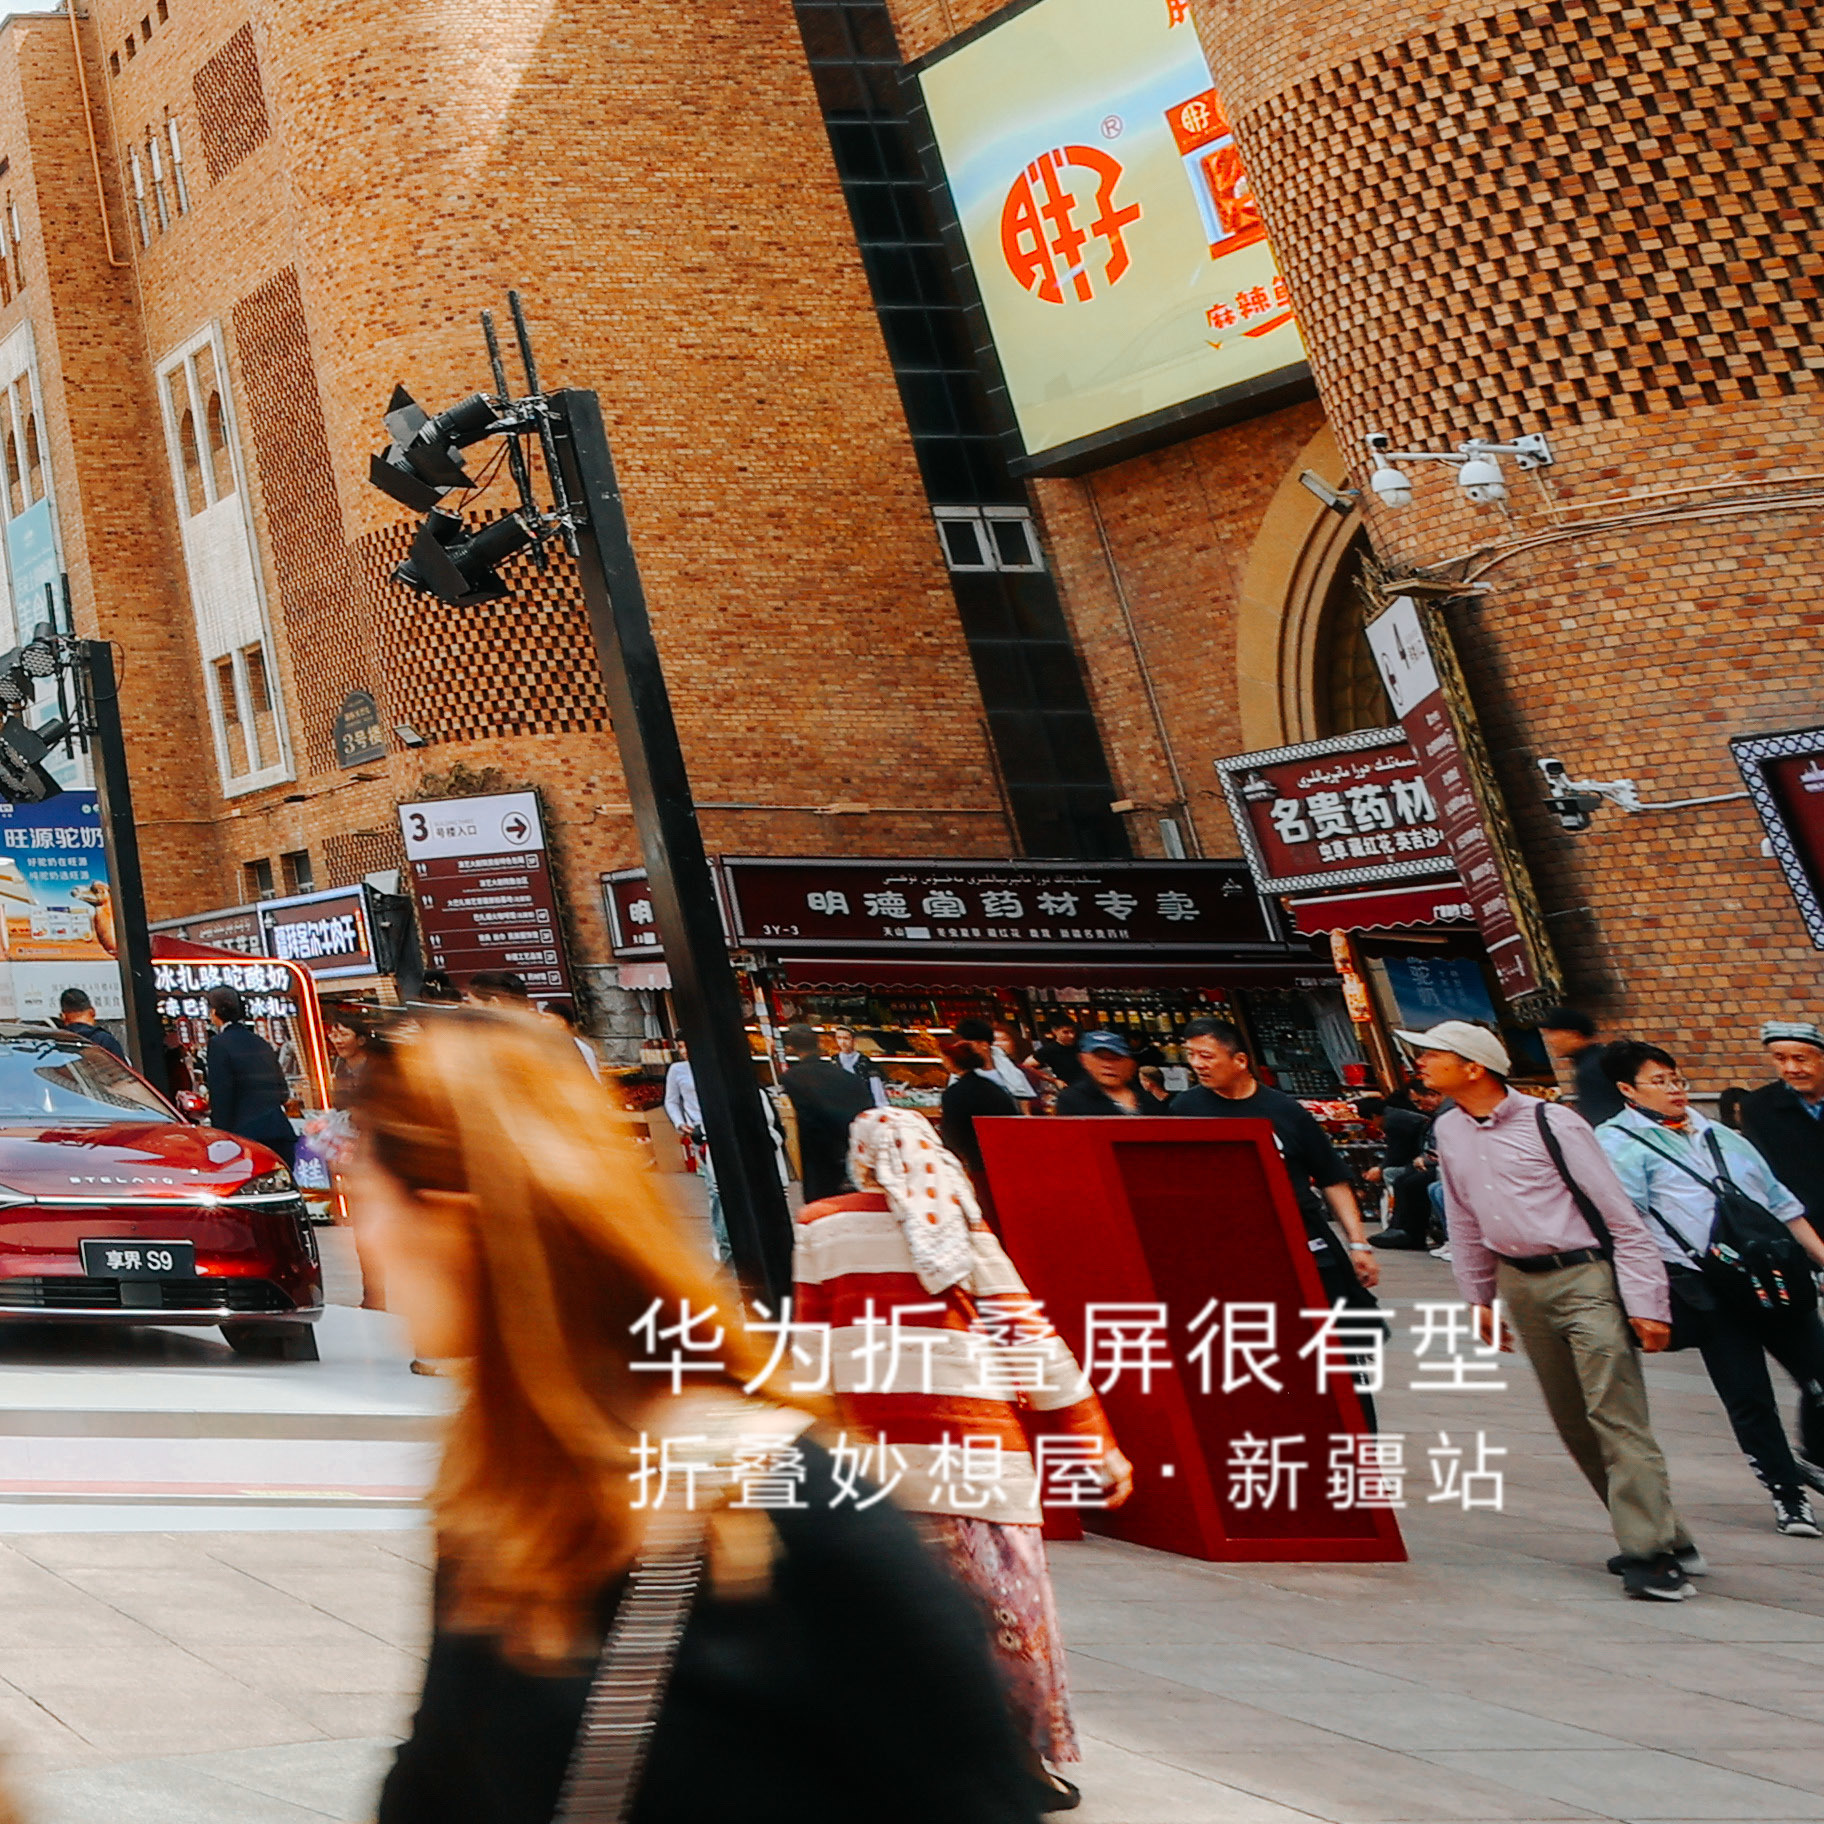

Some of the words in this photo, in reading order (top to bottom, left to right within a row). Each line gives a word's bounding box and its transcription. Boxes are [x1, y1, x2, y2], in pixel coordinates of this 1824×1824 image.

[342, 725, 383, 754] 3号楼
[1270, 776, 1438, 845] 名贵药材
[4, 827, 104, 849] 旺源驼奶
[408, 813, 429, 842] 3
[435, 825, 478, 838] 号楼入口
[1318, 840, 1349, 863] 虫草
[629, 899, 654, 925] 明
[807, 890, 1200, 921] 明德堂药材专卖
[763, 925, 799, 935] 3Y-3
[154, 964, 290, 993] 冰扎骆驼酸奶
[69, 1176, 173, 1185] STELATO
[105, 1249, 143, 1270] 享界
[146, 1249, 173, 1271] S9
